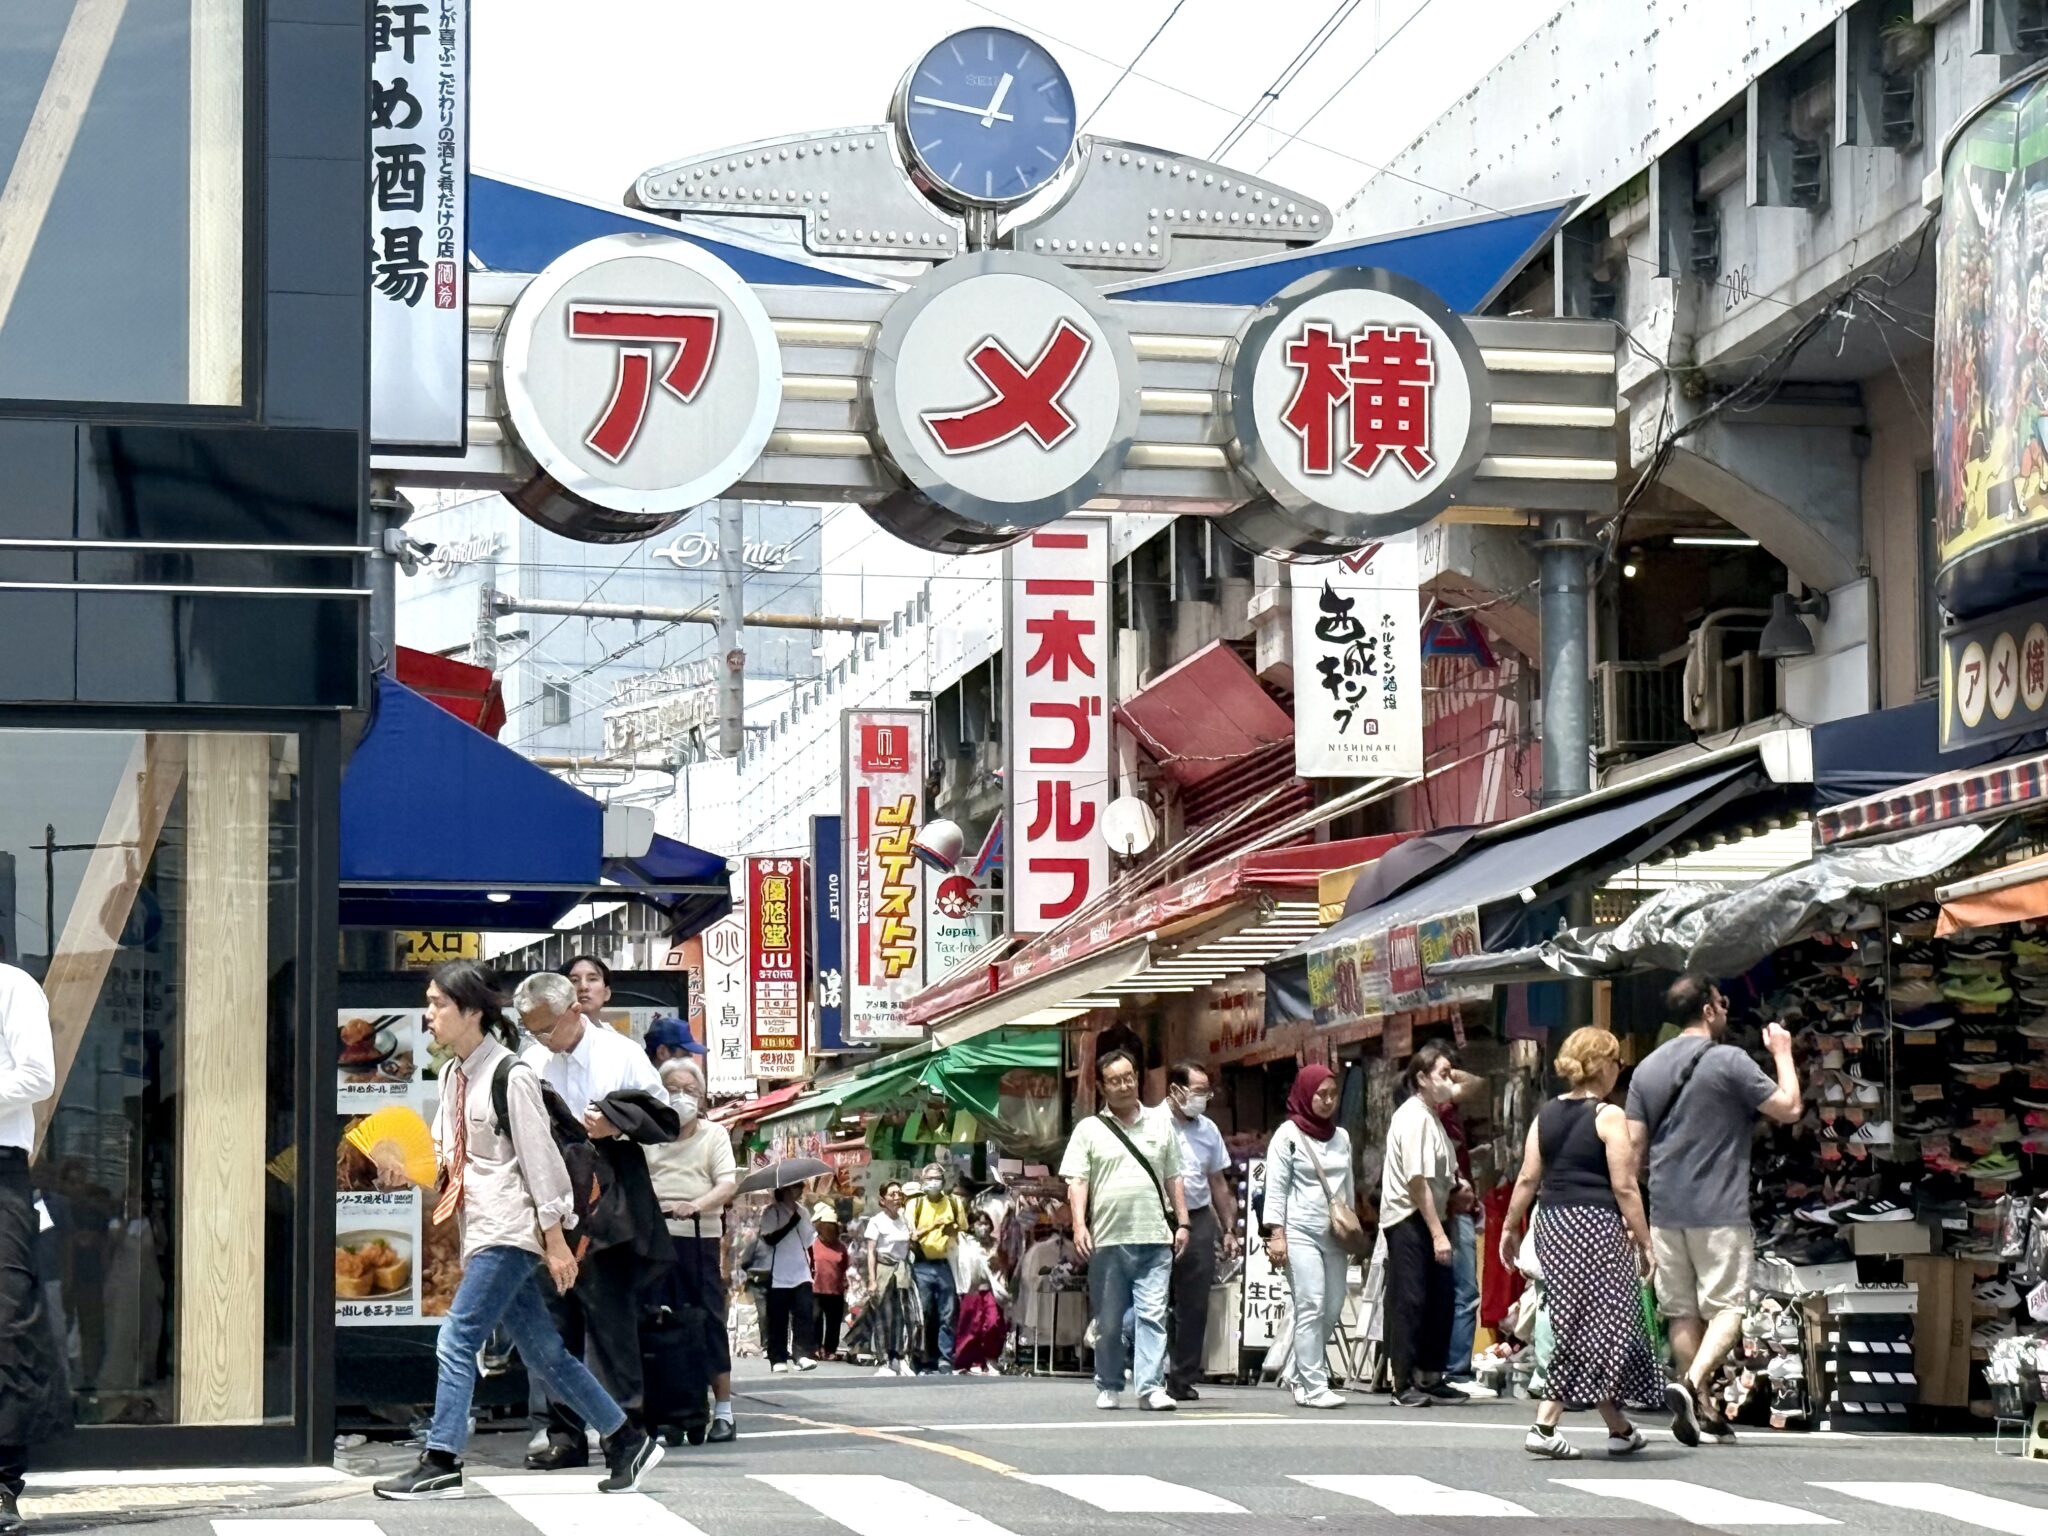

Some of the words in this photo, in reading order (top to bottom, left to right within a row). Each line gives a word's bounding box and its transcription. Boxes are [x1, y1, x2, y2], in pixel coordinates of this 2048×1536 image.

[1725, 264, 1750, 313] 206
[1026, 534, 1101, 919] 二木ゴルフ
[1328, 743, 1397, 752] NISHINARI
[1347, 755, 1379, 763] KING
[828, 873, 840, 921] OUTLET
[418, 932, 463, 953] 入口
[718, 973, 742, 1059] 小島屋
